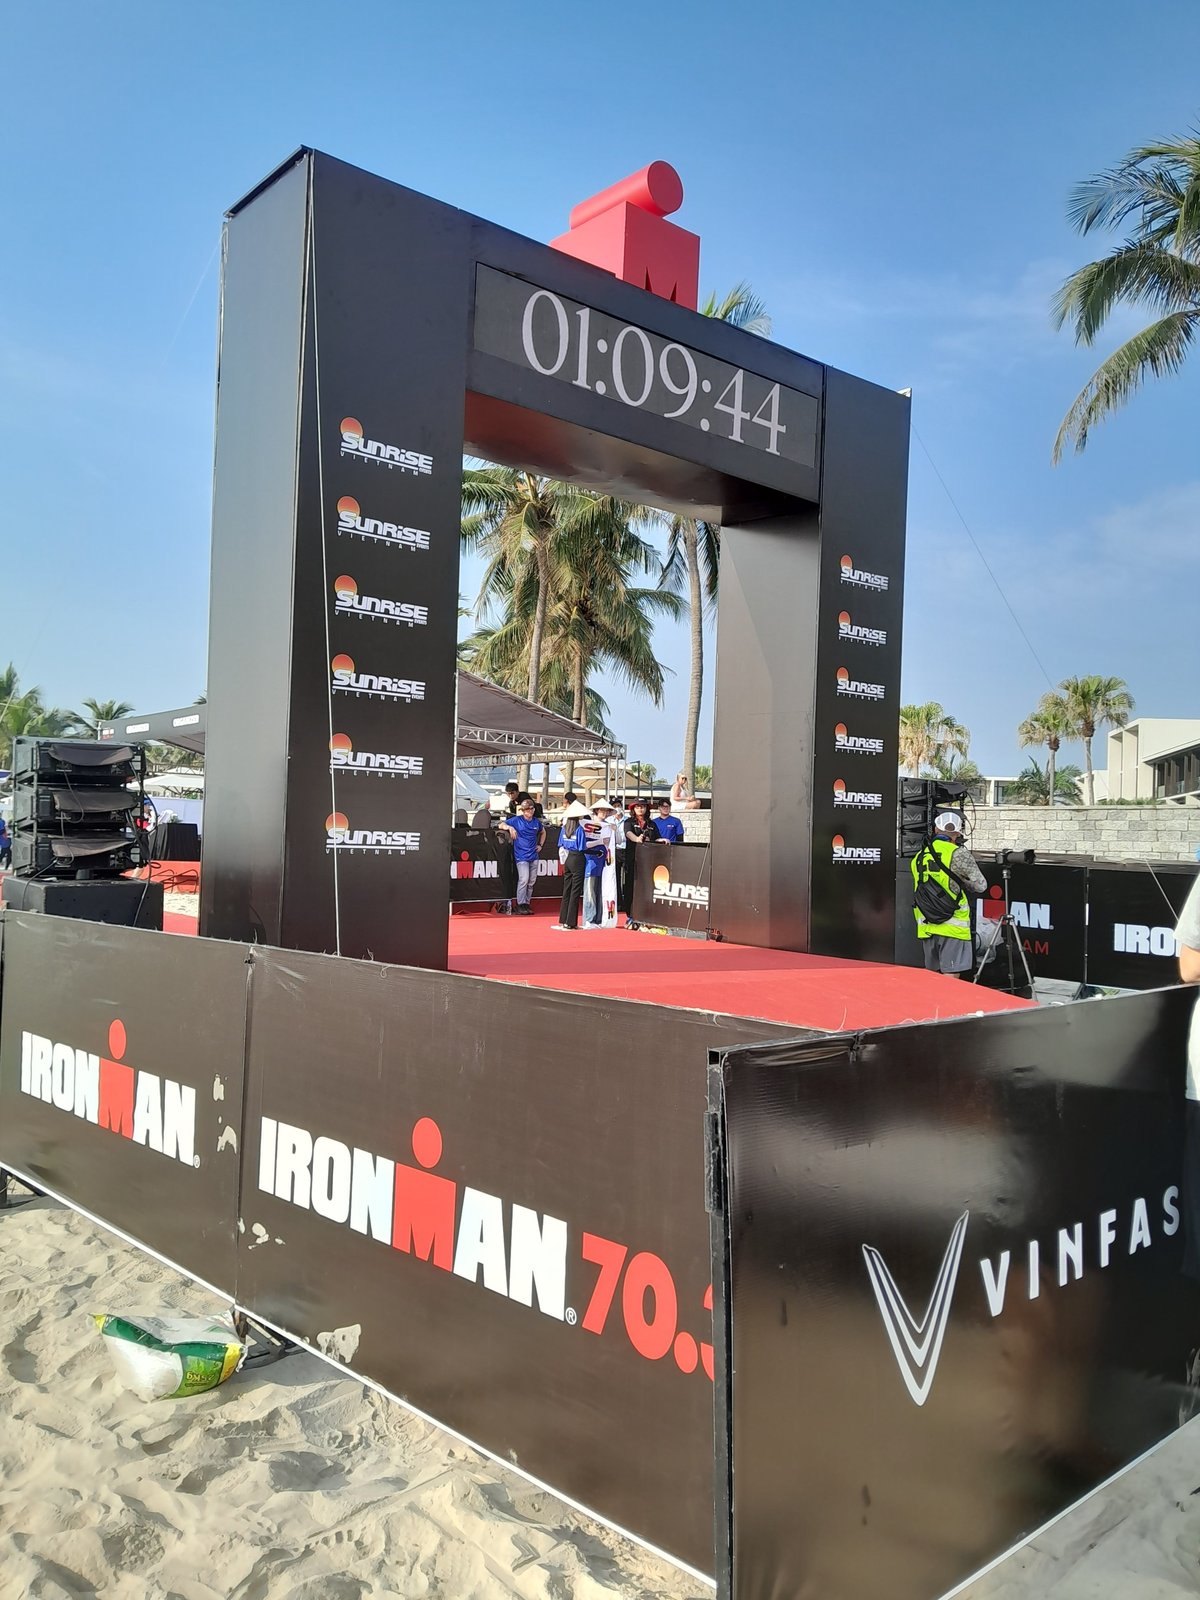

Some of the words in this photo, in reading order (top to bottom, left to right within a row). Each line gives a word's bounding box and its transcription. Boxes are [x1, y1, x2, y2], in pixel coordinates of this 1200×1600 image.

[522, 290, 786, 456] 01:09:44
[1114, 923, 1180, 957] IRO
[581, 1232, 715, 1382] 70.
